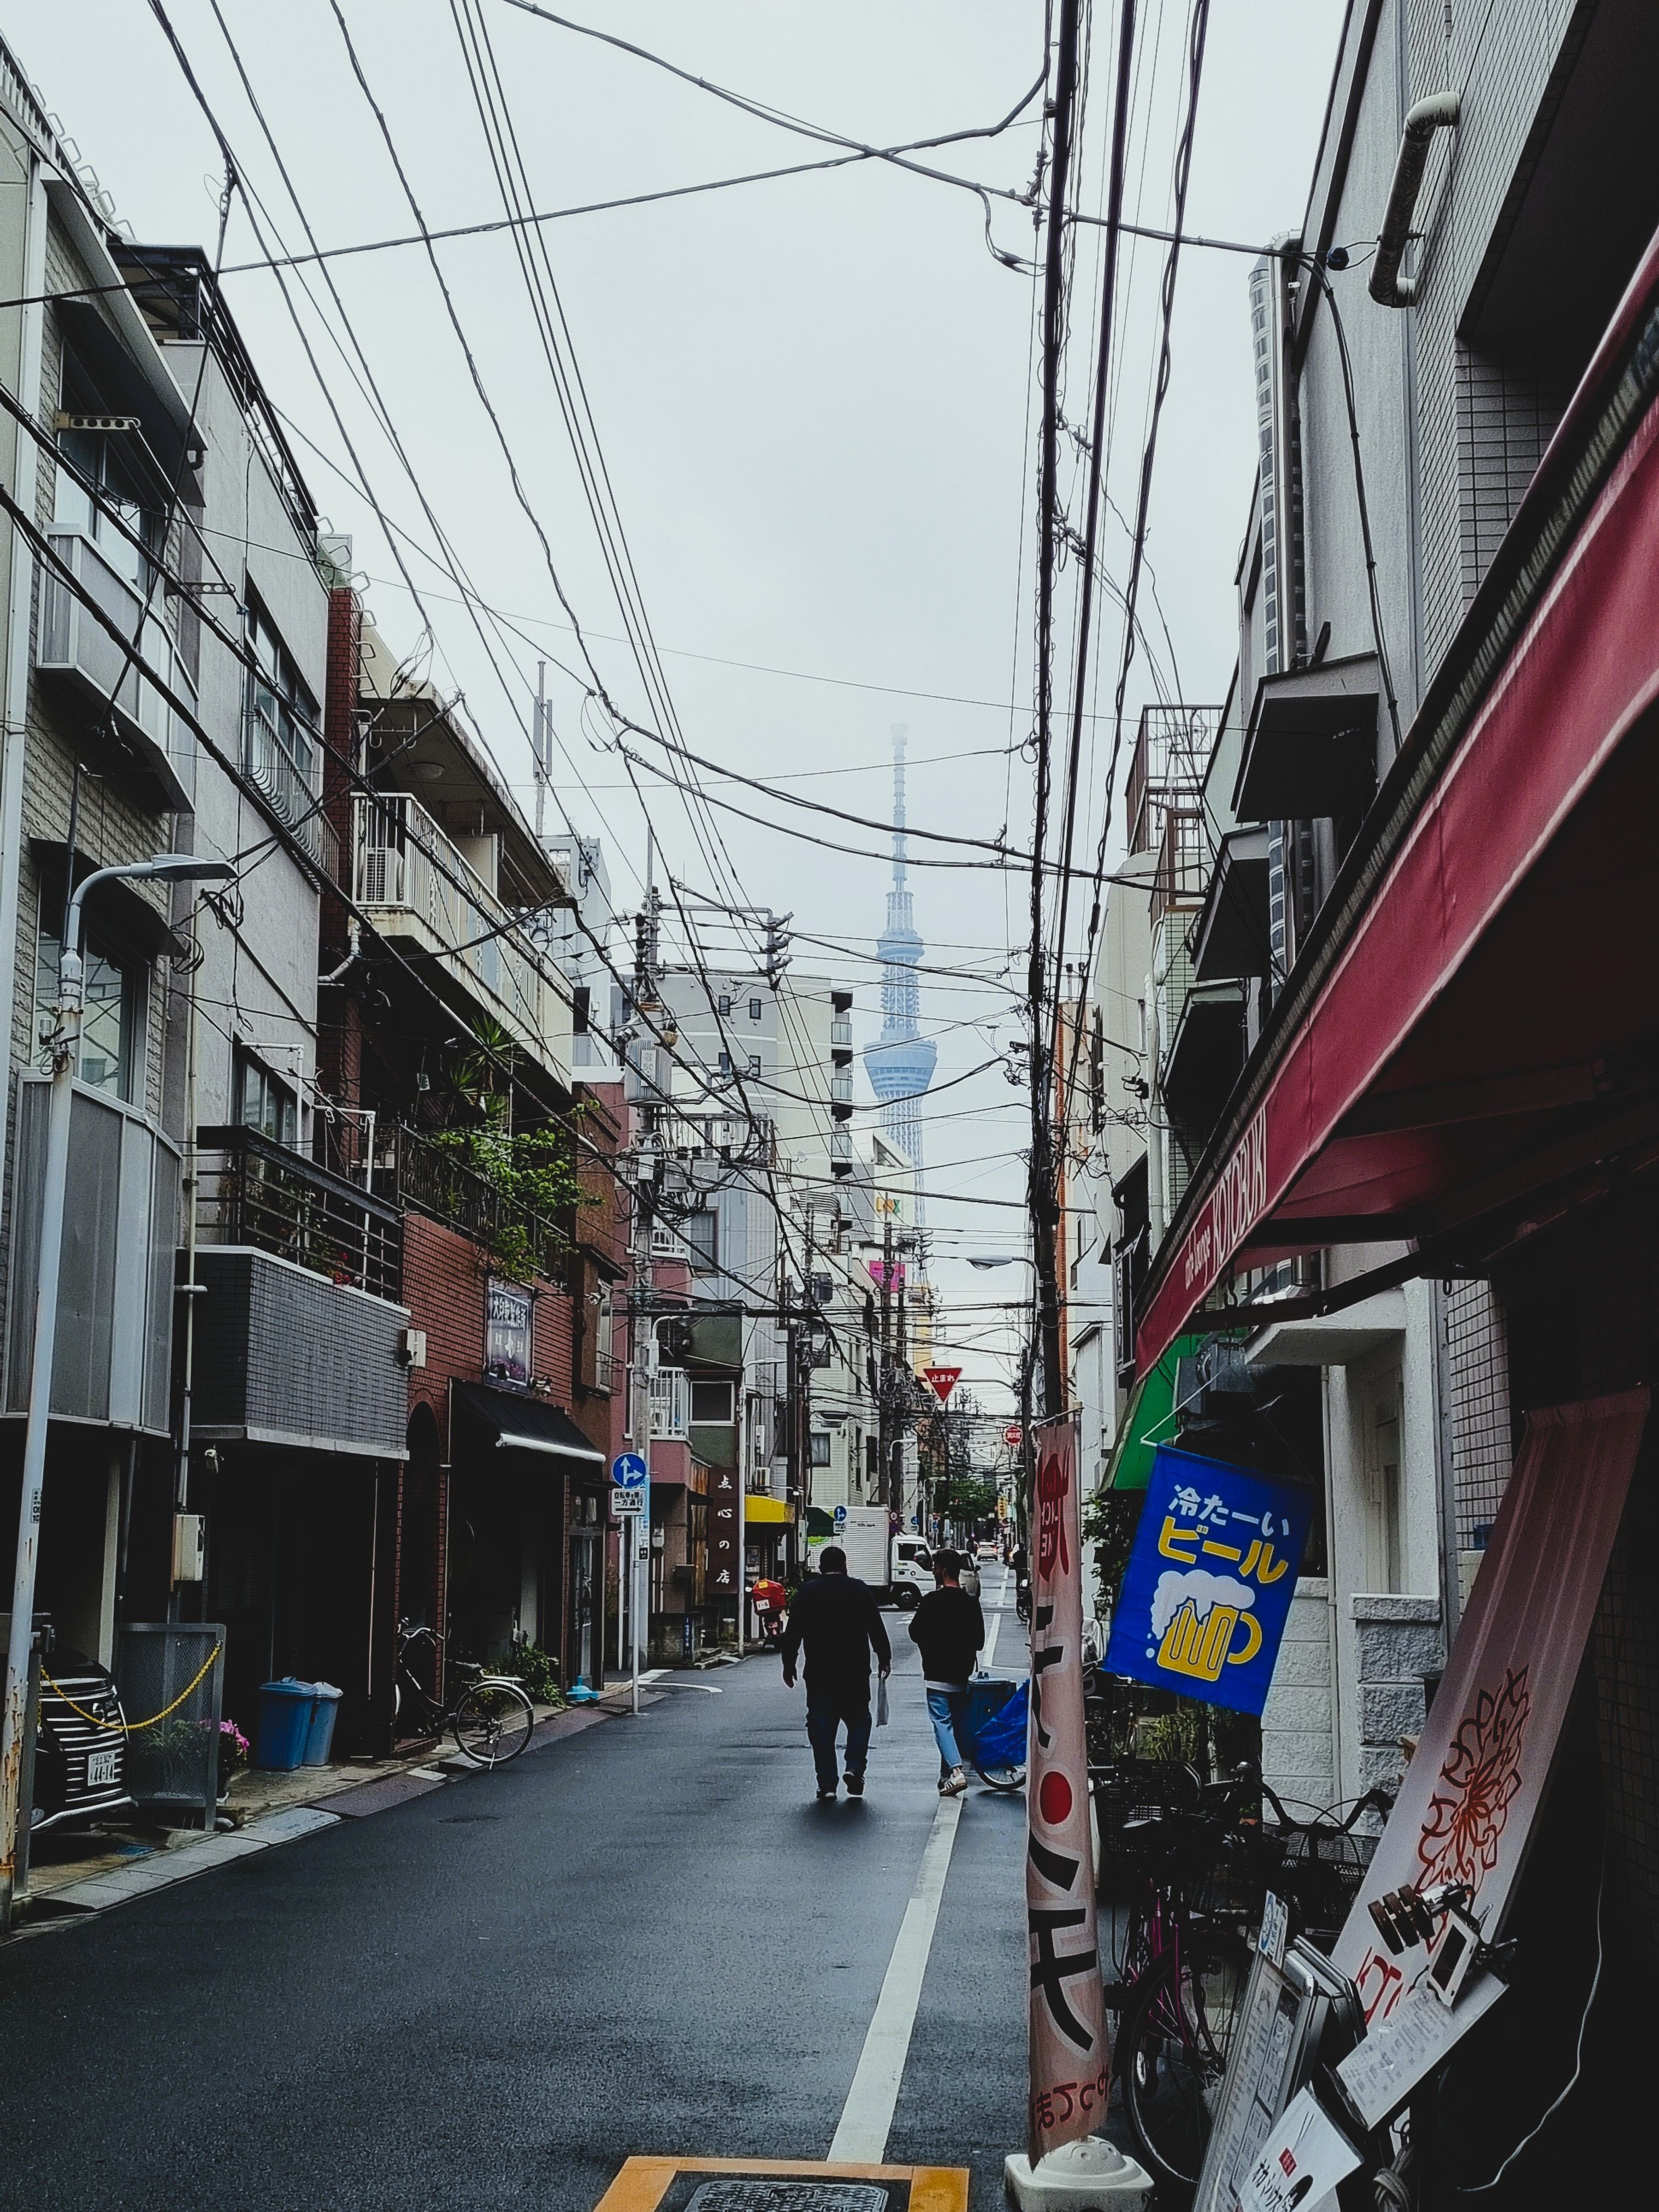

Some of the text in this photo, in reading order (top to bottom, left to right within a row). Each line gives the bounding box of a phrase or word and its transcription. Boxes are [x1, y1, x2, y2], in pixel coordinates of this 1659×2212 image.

[1212, 1105, 1267, 1275] KOTOBUKI
[931, 1374, 955, 1383] 止まれ
[1168, 1483, 1290, 1537] 冷たーい
[1158, 1515, 1289, 1584] ビール
